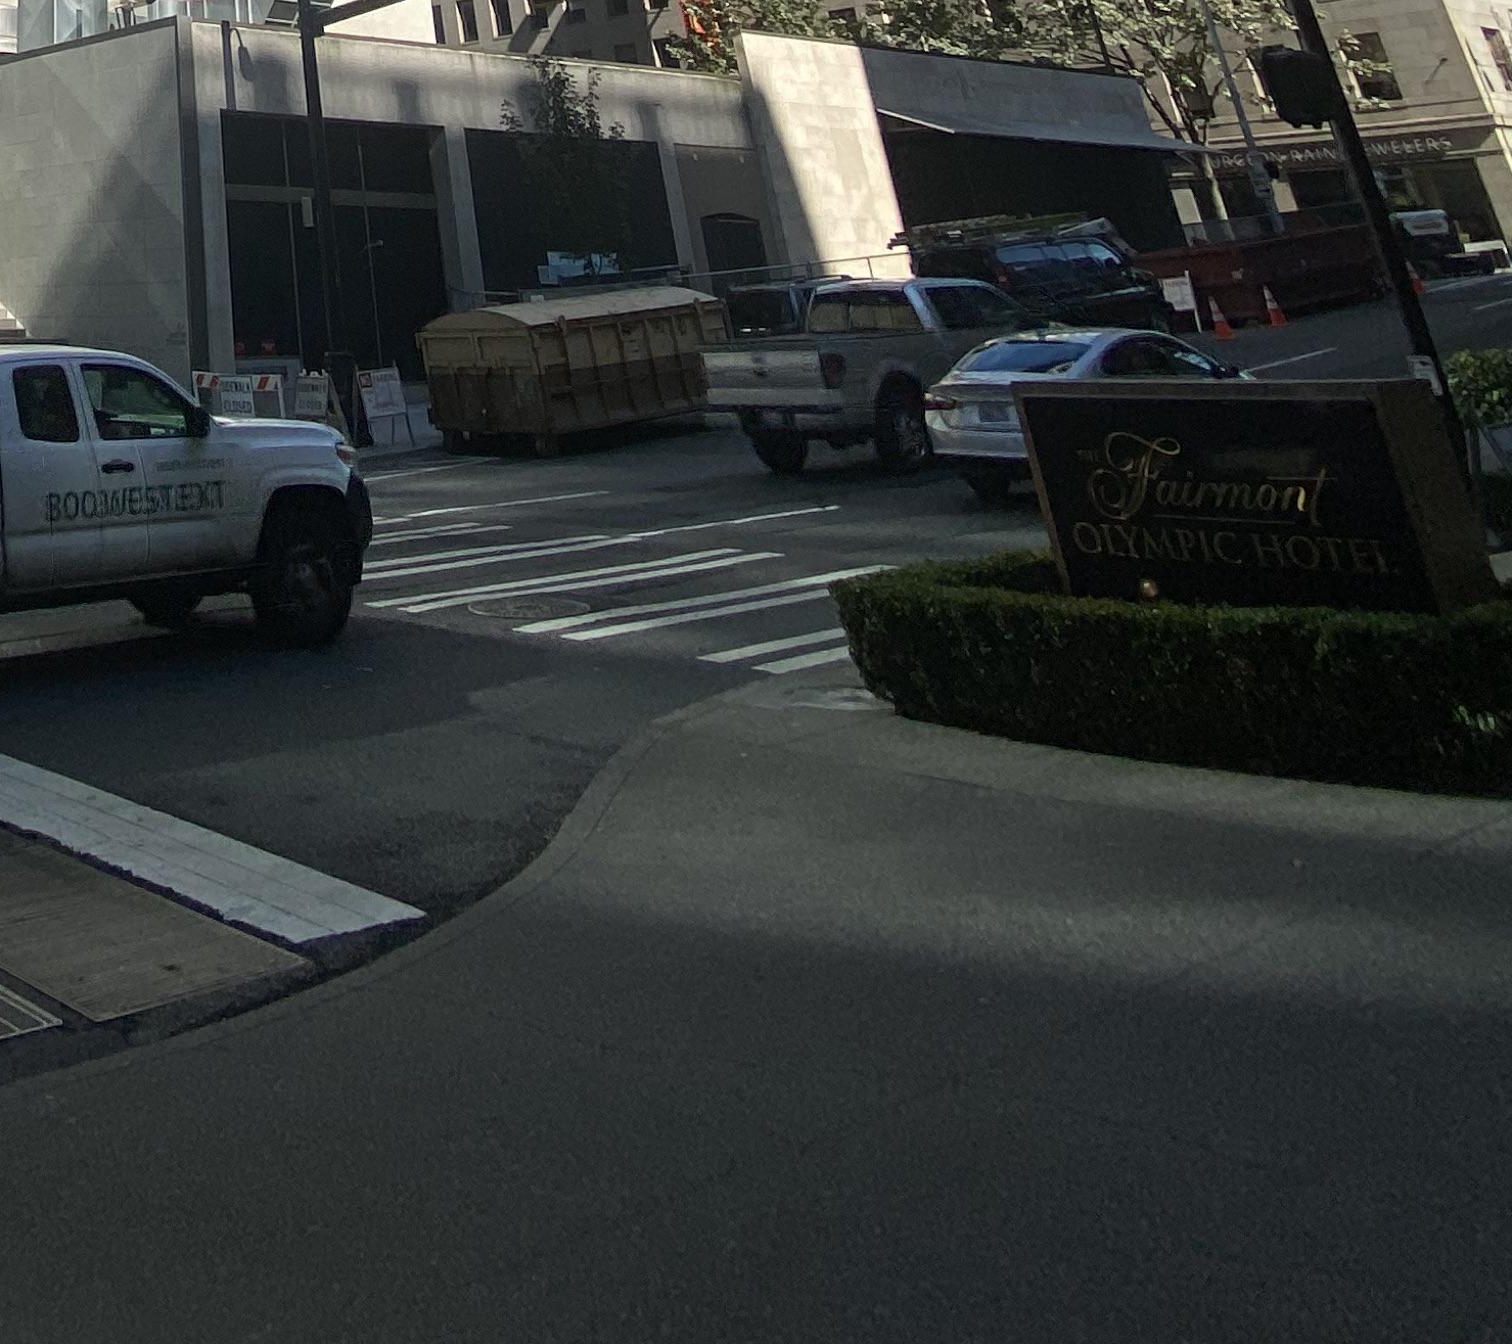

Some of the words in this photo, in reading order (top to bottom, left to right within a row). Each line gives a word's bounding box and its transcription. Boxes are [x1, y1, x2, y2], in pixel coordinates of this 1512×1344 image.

[1087, 430, 1337, 529] Fairmont
[1071, 520, 1243, 565] OLYMPIC
[1250, 532, 1396, 576] HOTEL
